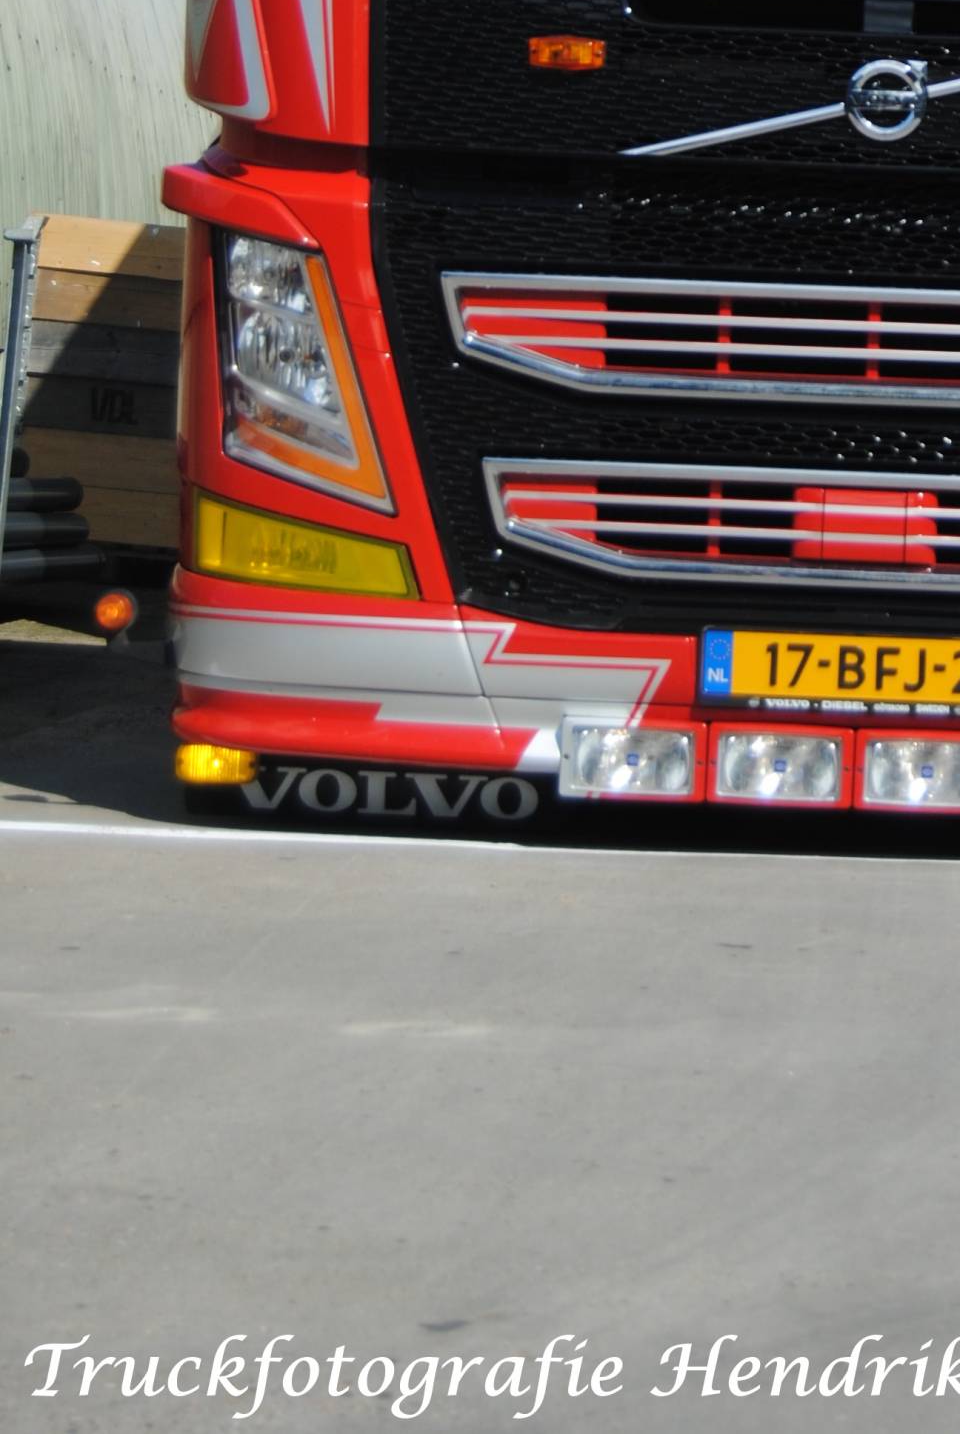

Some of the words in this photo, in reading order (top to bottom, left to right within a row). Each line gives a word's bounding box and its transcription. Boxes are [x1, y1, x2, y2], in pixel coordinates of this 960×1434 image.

[707, 667, 728, 683] NL
[764, 698, 810, 710] VOLVO
[240, 766, 539, 821] VOLVO
